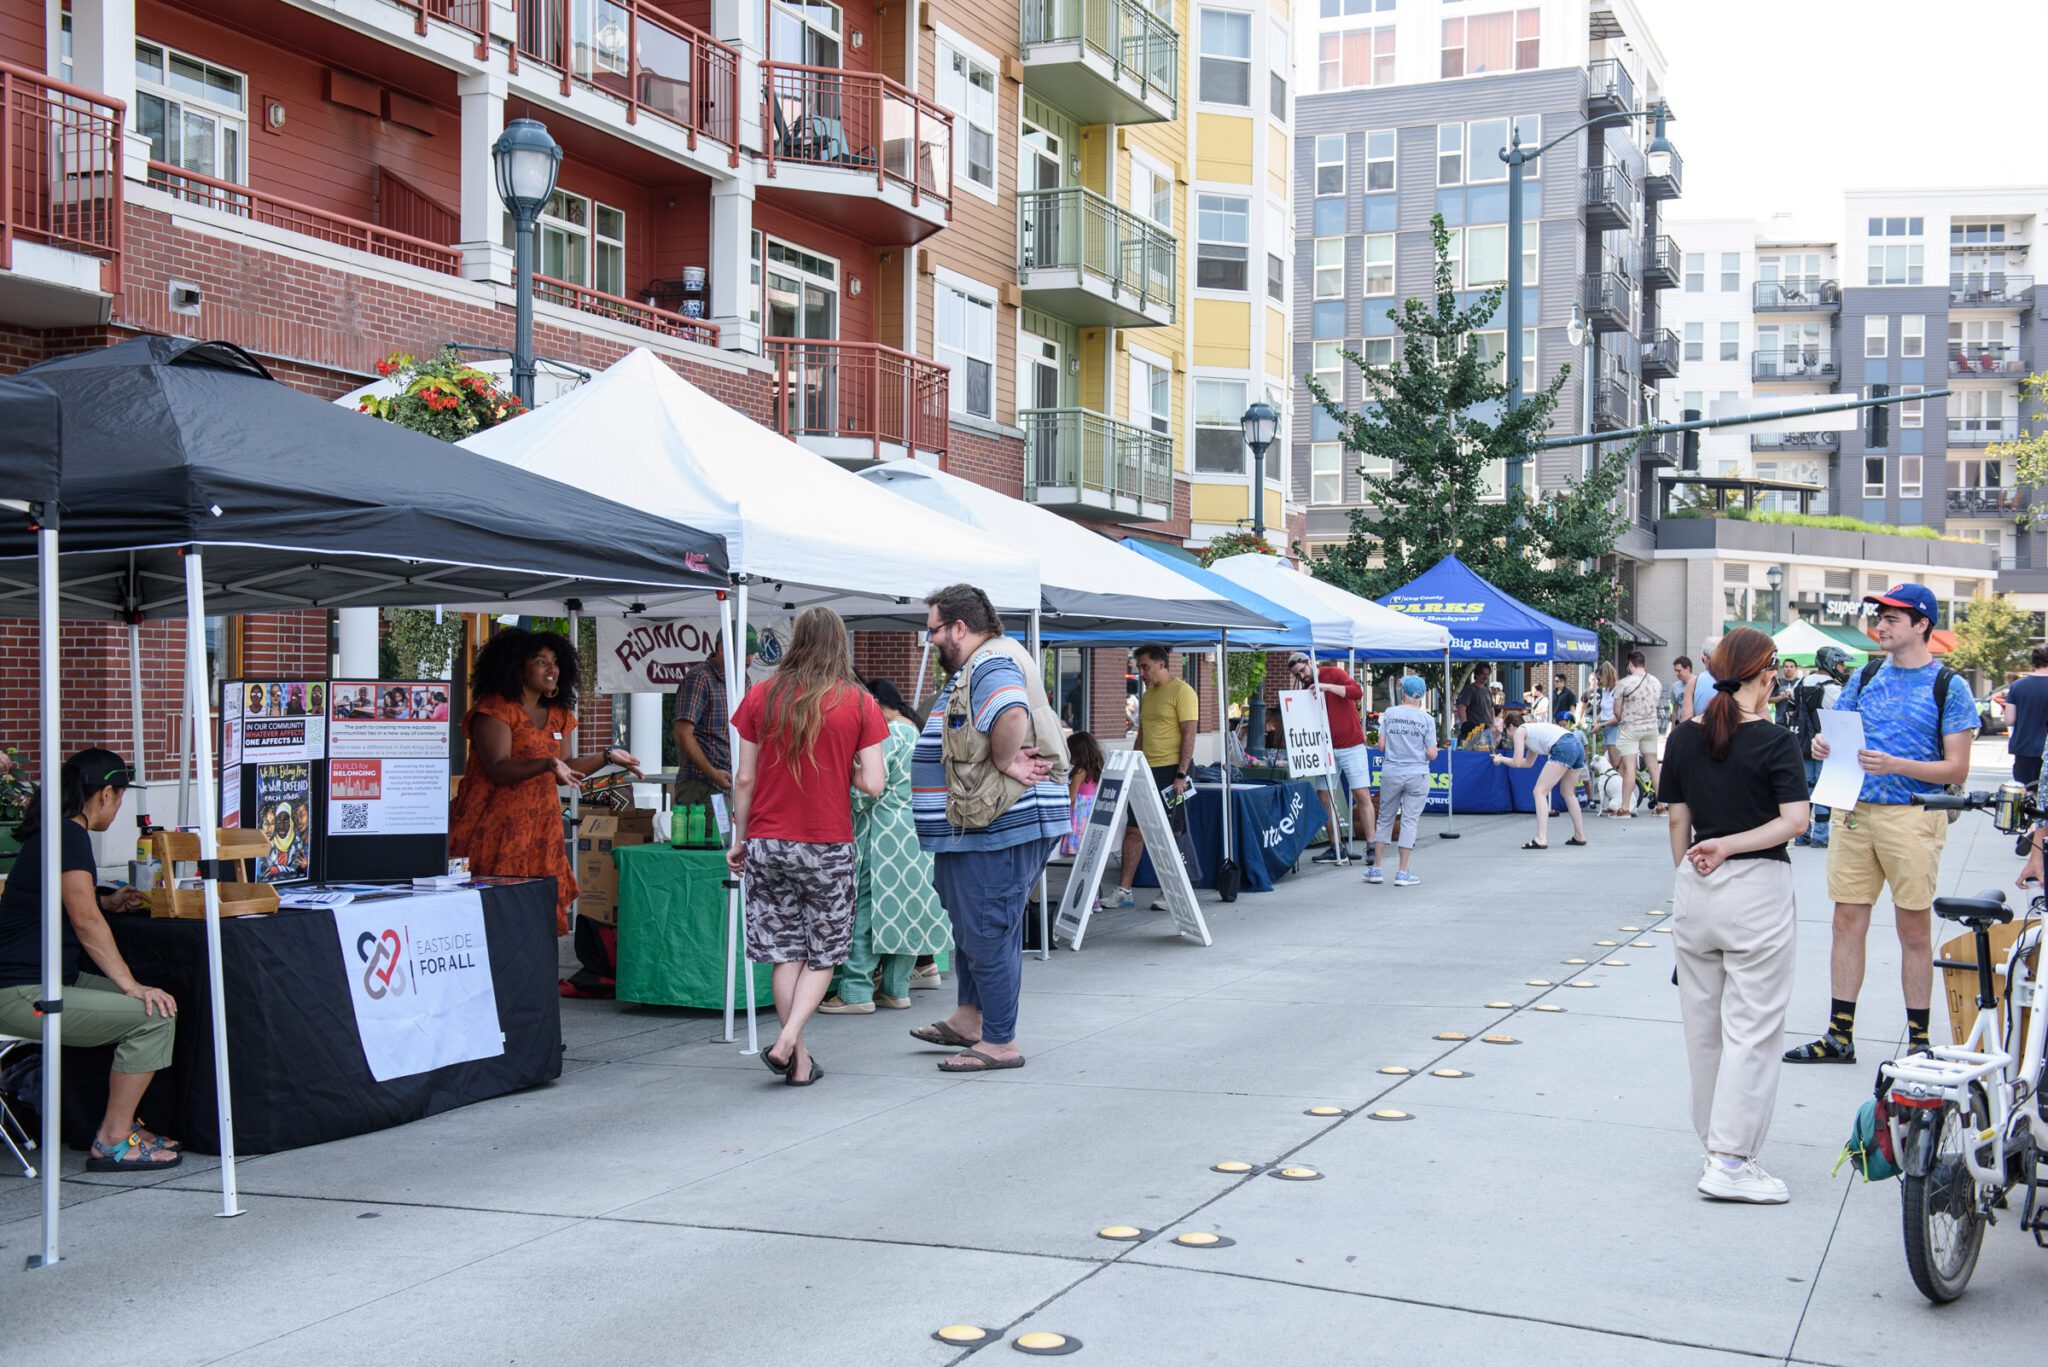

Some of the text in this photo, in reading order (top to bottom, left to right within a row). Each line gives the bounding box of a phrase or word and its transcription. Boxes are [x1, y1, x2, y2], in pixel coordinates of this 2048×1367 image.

[1386, 602, 1485, 613] PARKS
[1826, 600, 1861, 618] super
[1451, 638, 1472, 651] Big
[1473, 638, 1529, 651] Backyard
[246, 721, 304, 731] IN OUR COMMUNITY
[1388, 719, 1425, 729] COMMUNITY
[245, 729, 304, 738] WHATEVER AFFECTS
[245, 738, 260, 746] ONE
[261, 737, 290, 745] AFFECTS
[1292, 749, 1320, 770] wise
[416, 933, 472, 955] EASTSIDE
[420, 953, 475, 975] FOR ALL
